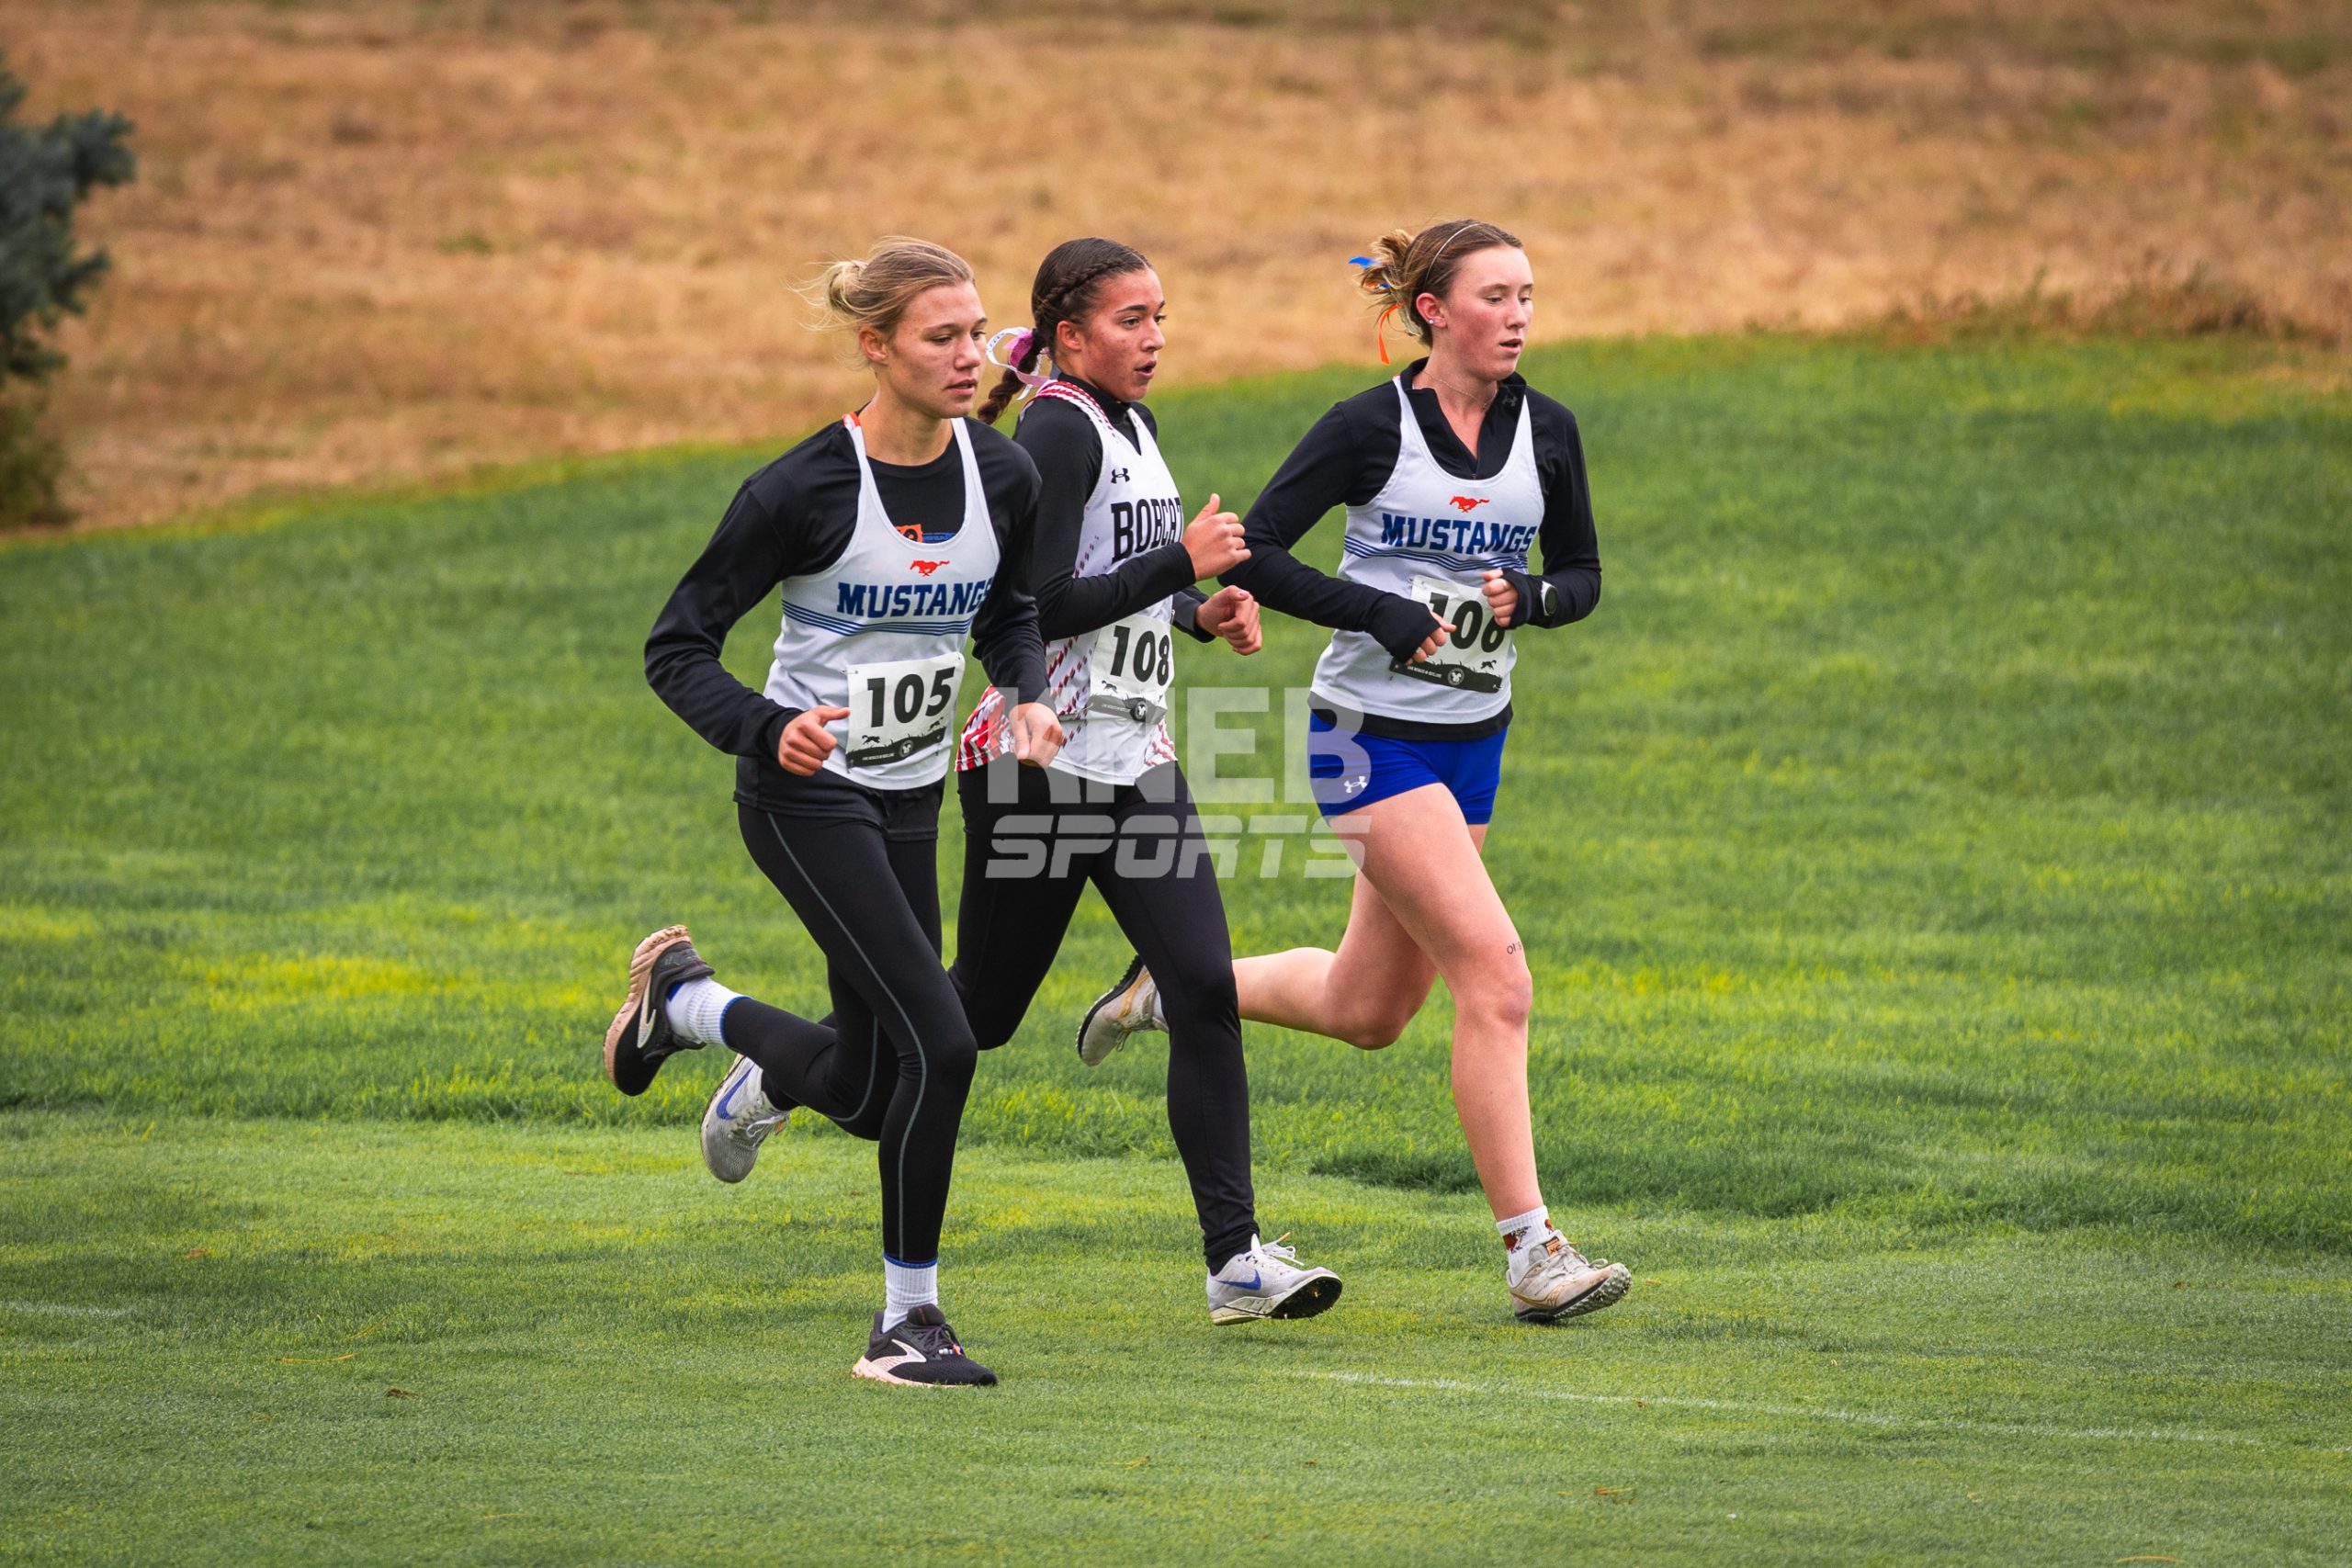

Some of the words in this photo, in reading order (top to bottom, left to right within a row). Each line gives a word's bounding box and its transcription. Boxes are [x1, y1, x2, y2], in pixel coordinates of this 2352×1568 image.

[1381, 513, 1537, 553] MUSTANGS
[1110, 626, 1170, 686] 108
[867, 667, 956, 728] 105
